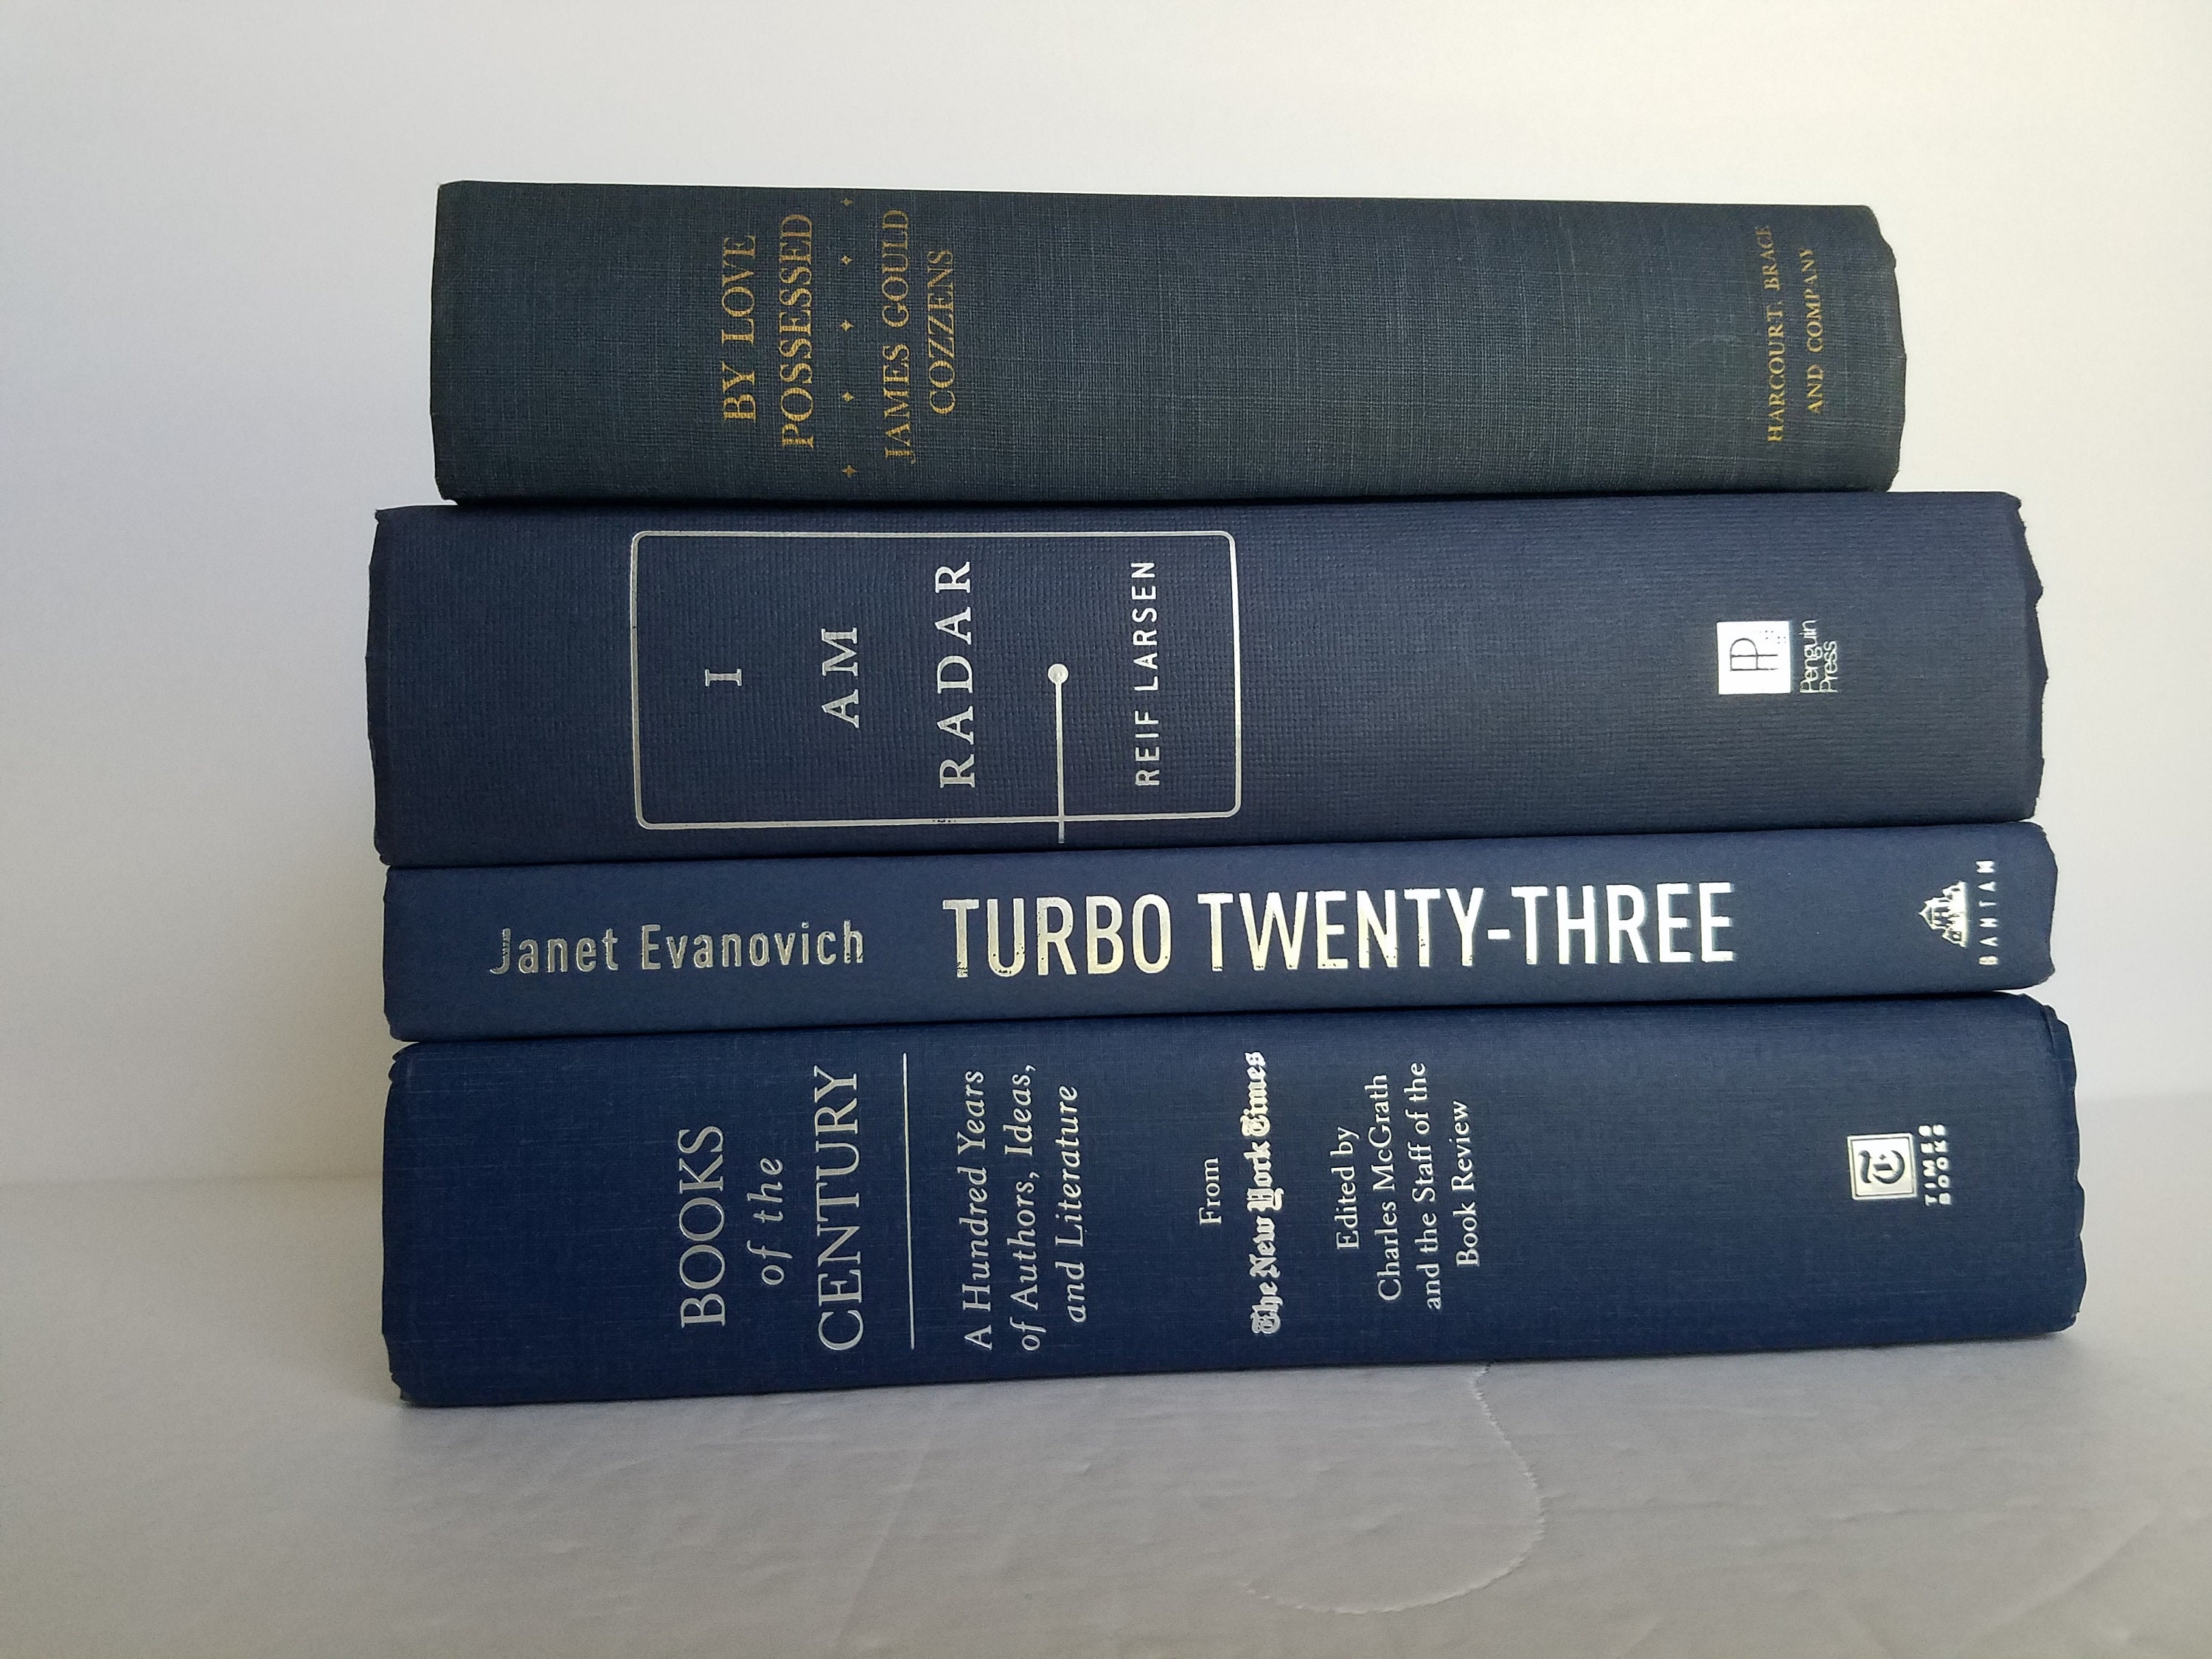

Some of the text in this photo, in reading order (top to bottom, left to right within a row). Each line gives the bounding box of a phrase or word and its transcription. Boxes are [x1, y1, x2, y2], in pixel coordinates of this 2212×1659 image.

[721, 235, 757, 422] BY LOVE
[779, 214, 813, 448] POSSESSED
[882, 209, 916, 464] JAMES GOULD
[928, 249, 956, 414] COZZENS
[1755, 226, 1780, 291] BRACE
[1799, 248, 1824, 414] AND COMPANY
[705, 668, 742, 686] I
[821, 627, 858, 728] AM
[935, 561, 975, 788] RADAR
[1131, 562, 1159, 786] REIF LARSEN
[1799, 620, 1822, 693] Penguin
[1820, 641, 1838, 693] Press
[490, 919, 864, 975] Janet Evanovich
[943, 882, 1734, 978] TURBO TWENTY-THREE
[678, 1125, 726, 1328] BOOKS
[747, 1158, 793, 1285] of the
[813, 1065, 864, 1350] CENTURY
[958, 1070, 992, 1350] A Hundred Years
[1004, 1065, 1046, 1351] of Authors, Ideas,
[1054, 1085, 1087, 1323] and Literature
[1199, 1157, 1222, 1225] From
[1240, 1051, 1284, 1334] The New York Times
[1330, 1127, 1360, 1250] Edited by
[1365, 1074, 1402, 1301] Charles McGrath
[1404, 1062, 1441, 1310] and the Staff of the
[1449, 1100, 1479, 1266] Book Review
